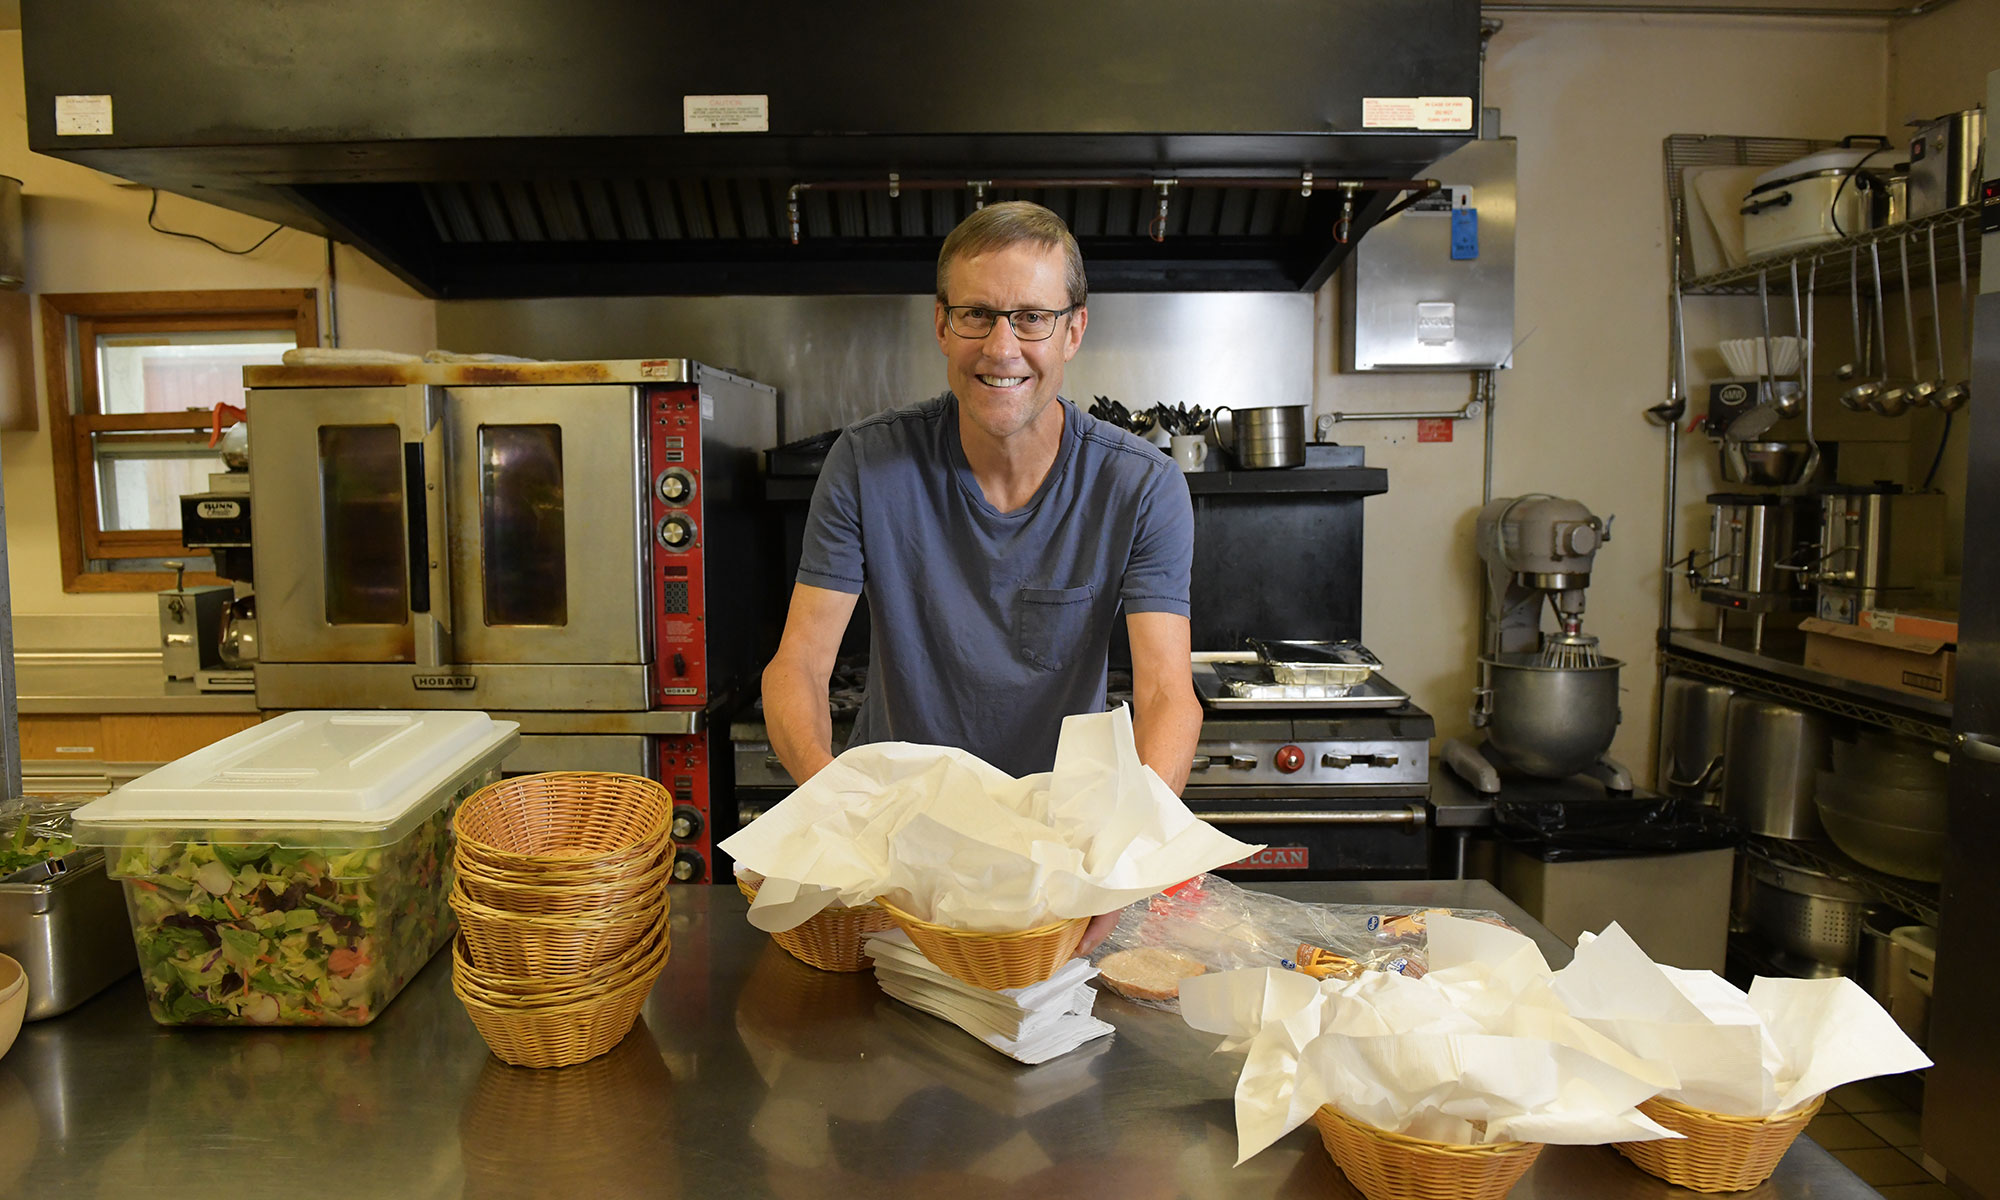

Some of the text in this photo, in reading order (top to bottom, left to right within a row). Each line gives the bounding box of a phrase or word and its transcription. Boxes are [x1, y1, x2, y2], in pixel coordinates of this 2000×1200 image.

[204, 503, 233, 511] BUNN
[419, 677, 471, 686] HOBART
[1236, 851, 1304, 865] LCAN
